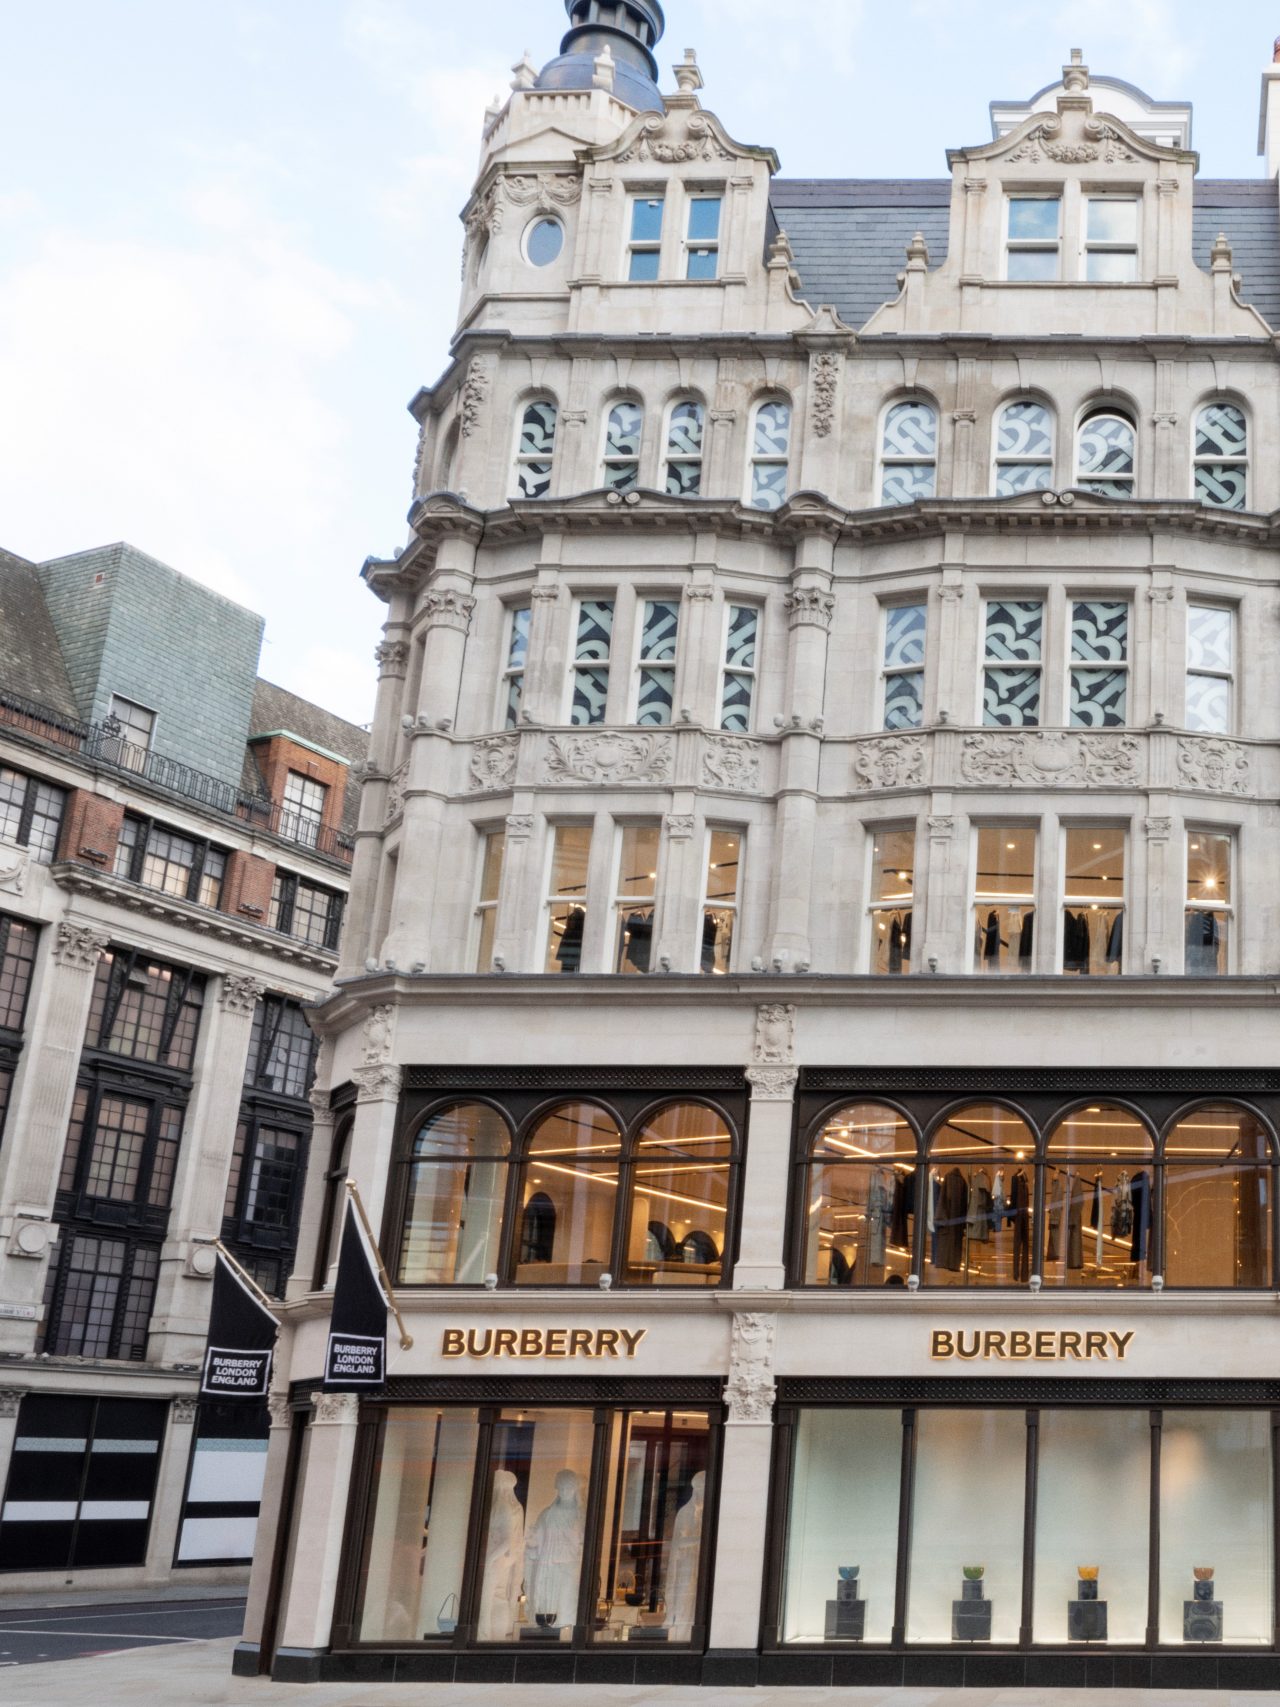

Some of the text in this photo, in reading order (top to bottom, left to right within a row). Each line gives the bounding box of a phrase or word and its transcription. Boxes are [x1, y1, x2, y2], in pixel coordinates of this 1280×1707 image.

[441, 1328, 647, 1357] BURBERRY
[931, 1329, 1135, 1359] BURBERRY
[333, 1344, 378, 1356] BURBERRY
[212, 1357, 263, 1369] BURBERRY
[337, 1354, 374, 1364] LONDON
[215, 1366, 257, 1377] LONDON
[333, 1364, 376, 1374] ENGLAND
[211, 1375, 258, 1386] ENGLAND
